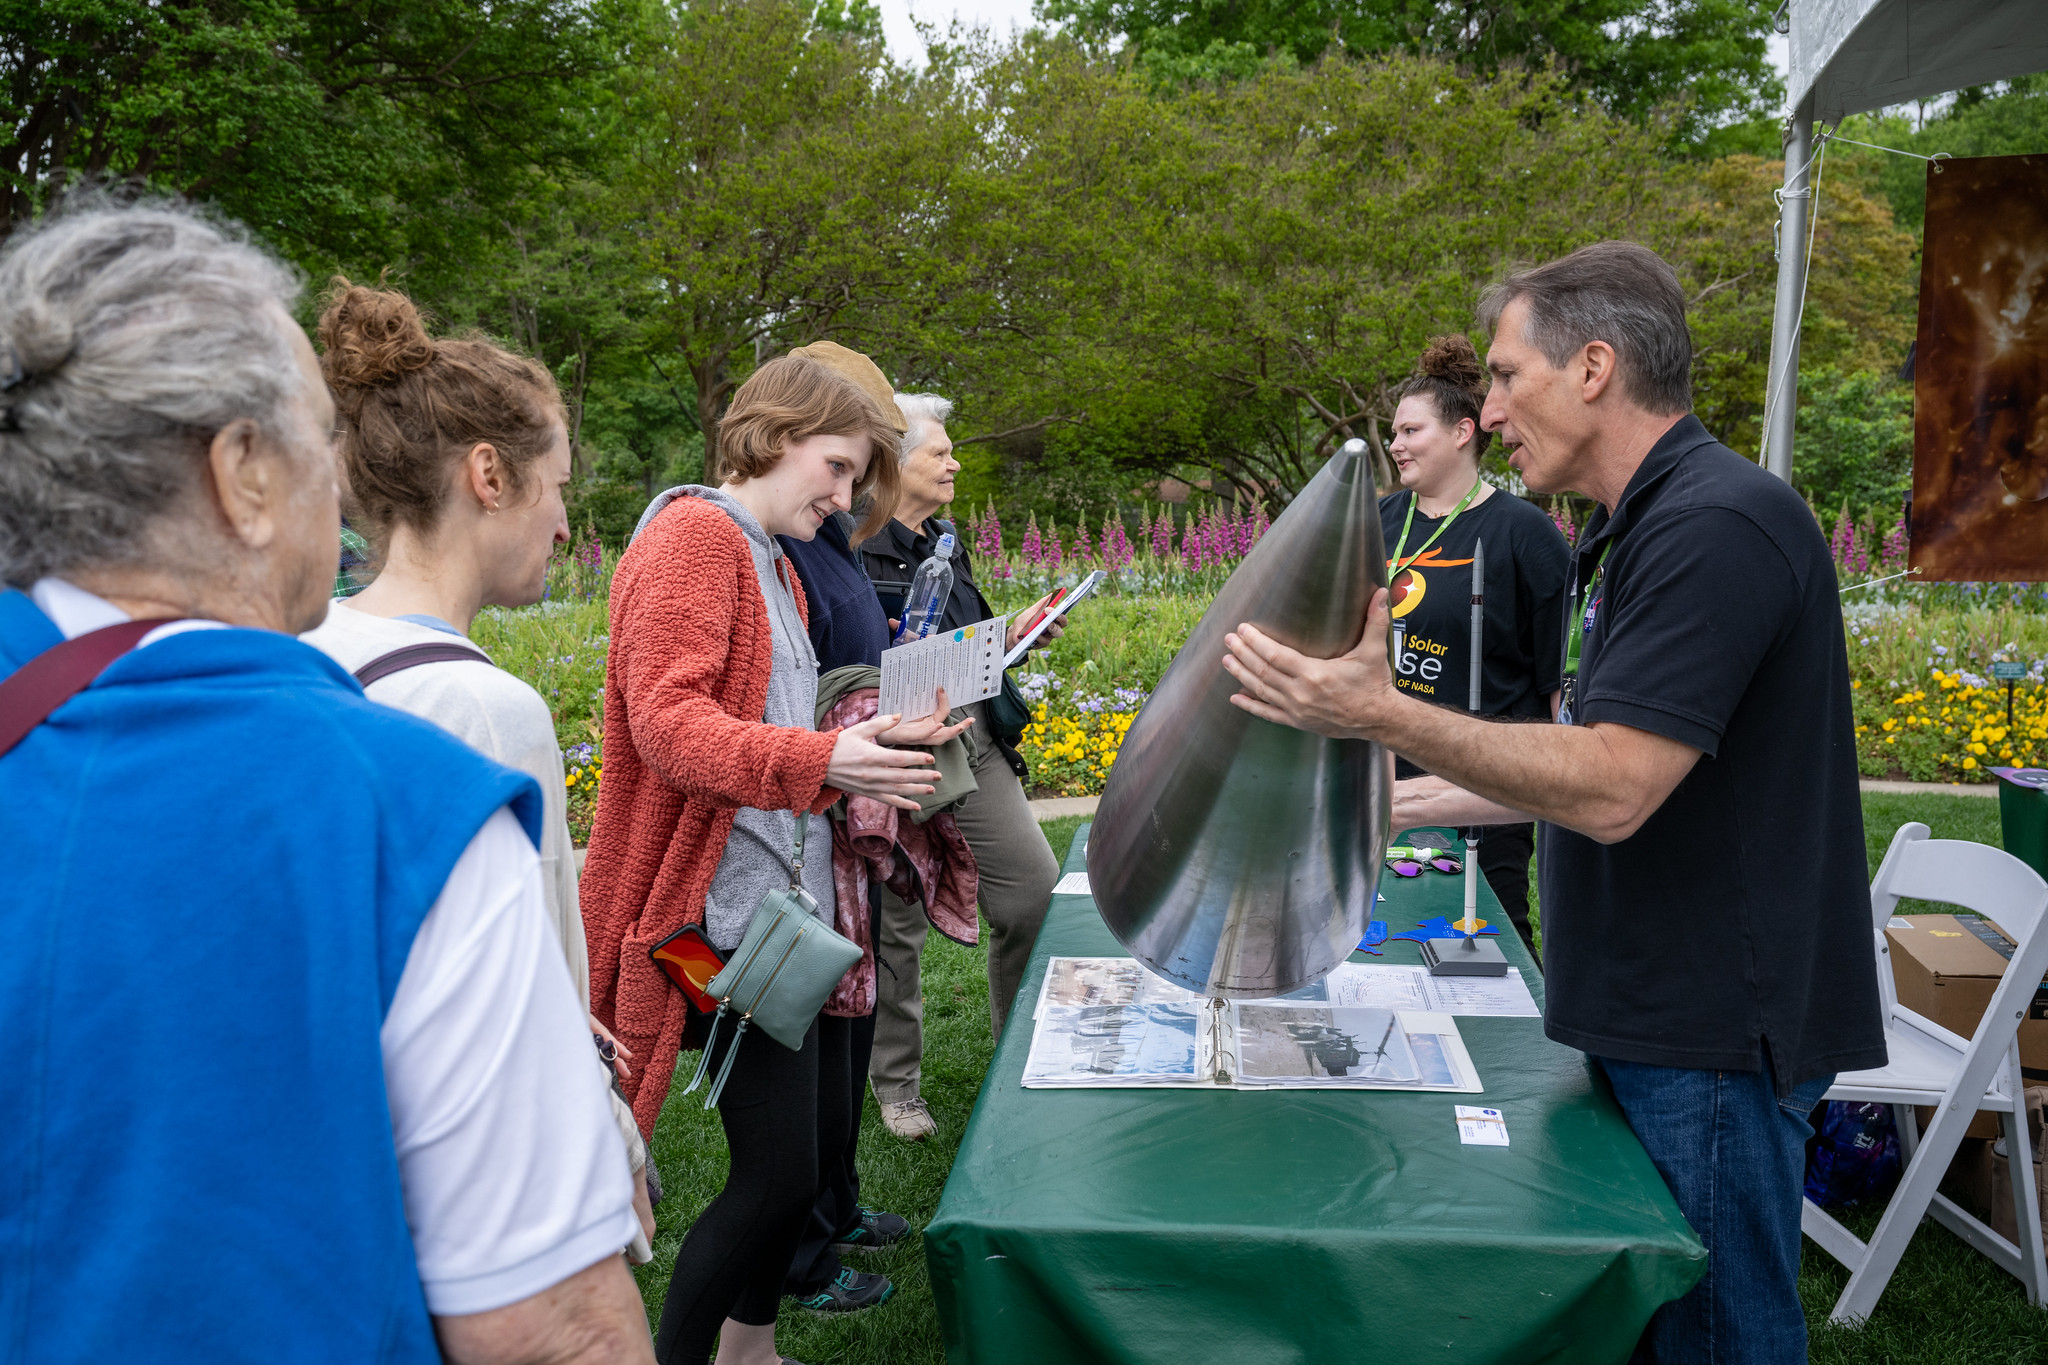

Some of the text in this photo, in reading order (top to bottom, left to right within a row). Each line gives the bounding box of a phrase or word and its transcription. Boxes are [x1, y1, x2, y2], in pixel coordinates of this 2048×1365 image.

[1408, 635, 1448, 656] Solar
[1397, 679, 1434, 694] OF NASA
